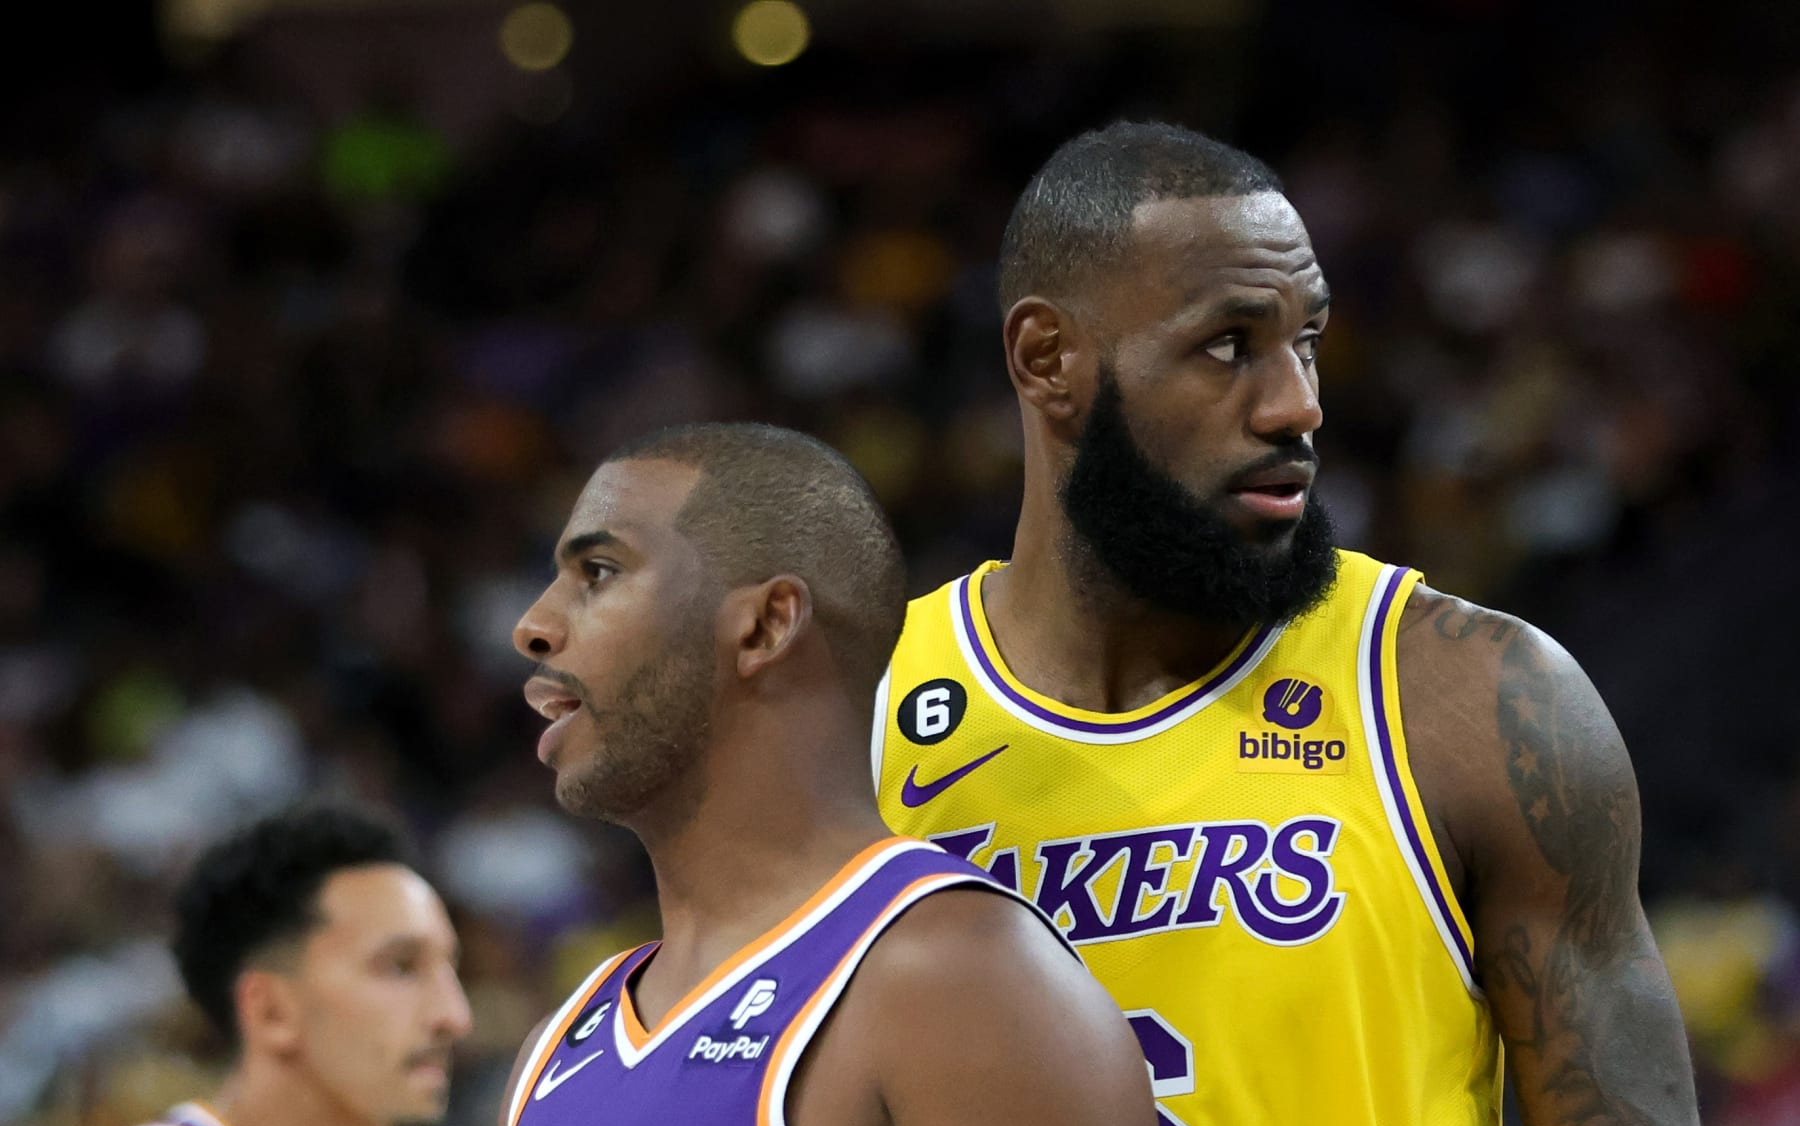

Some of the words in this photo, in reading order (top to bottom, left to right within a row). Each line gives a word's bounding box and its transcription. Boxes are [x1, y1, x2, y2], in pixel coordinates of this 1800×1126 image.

[916, 687, 950, 738] 6
[1239, 731, 1346, 770] bibigo
[575, 1001, 612, 1041] 6
[688, 1034, 770, 1064] PayPal
